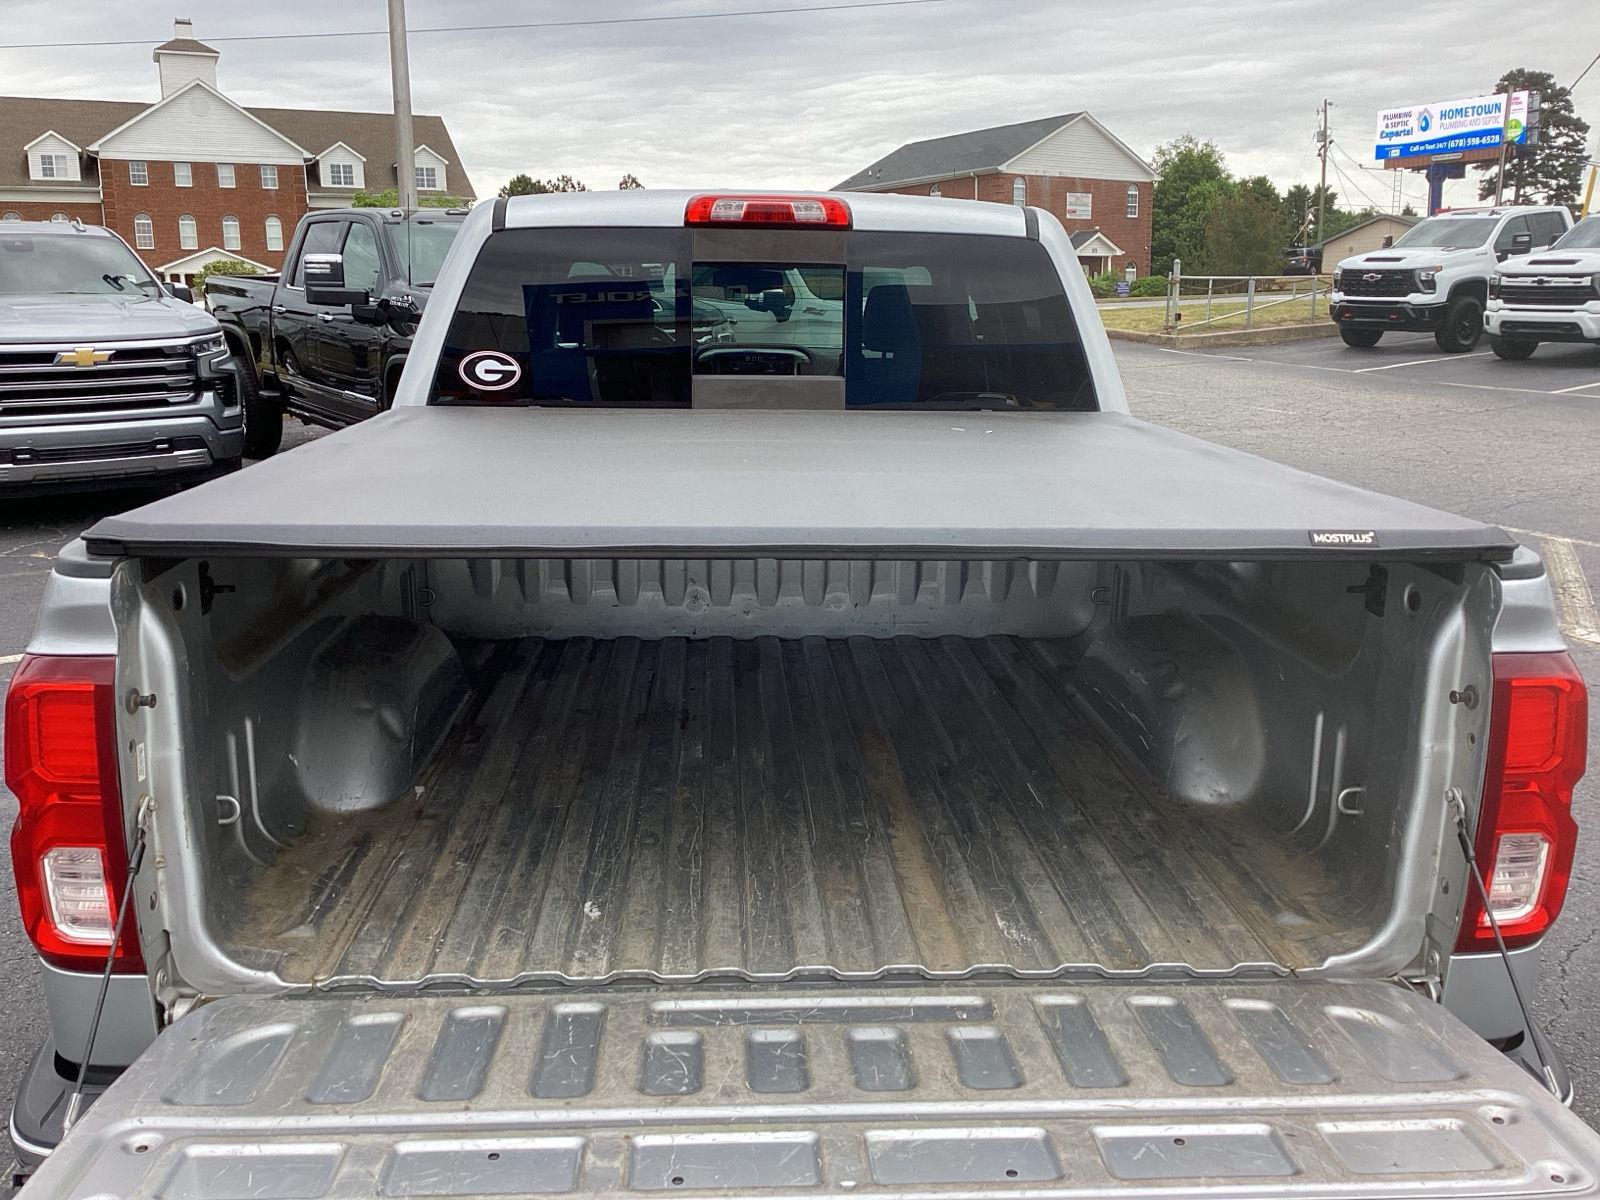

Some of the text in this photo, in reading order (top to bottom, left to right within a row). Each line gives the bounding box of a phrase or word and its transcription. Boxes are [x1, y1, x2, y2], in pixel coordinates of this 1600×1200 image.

[1383, 111, 1413, 121] PLUMBING
[1440, 102, 1501, 120] HOMETOWN
[1390, 120, 1409, 128] SEPTIC
[1440, 115, 1500, 130] PLUMBING AND SEPTIC
[1448, 138, 1466, 149] (678)
[1467, 134, 1500, 146] 598-6528
[1313, 532, 1373, 544] MOSTPLUS
